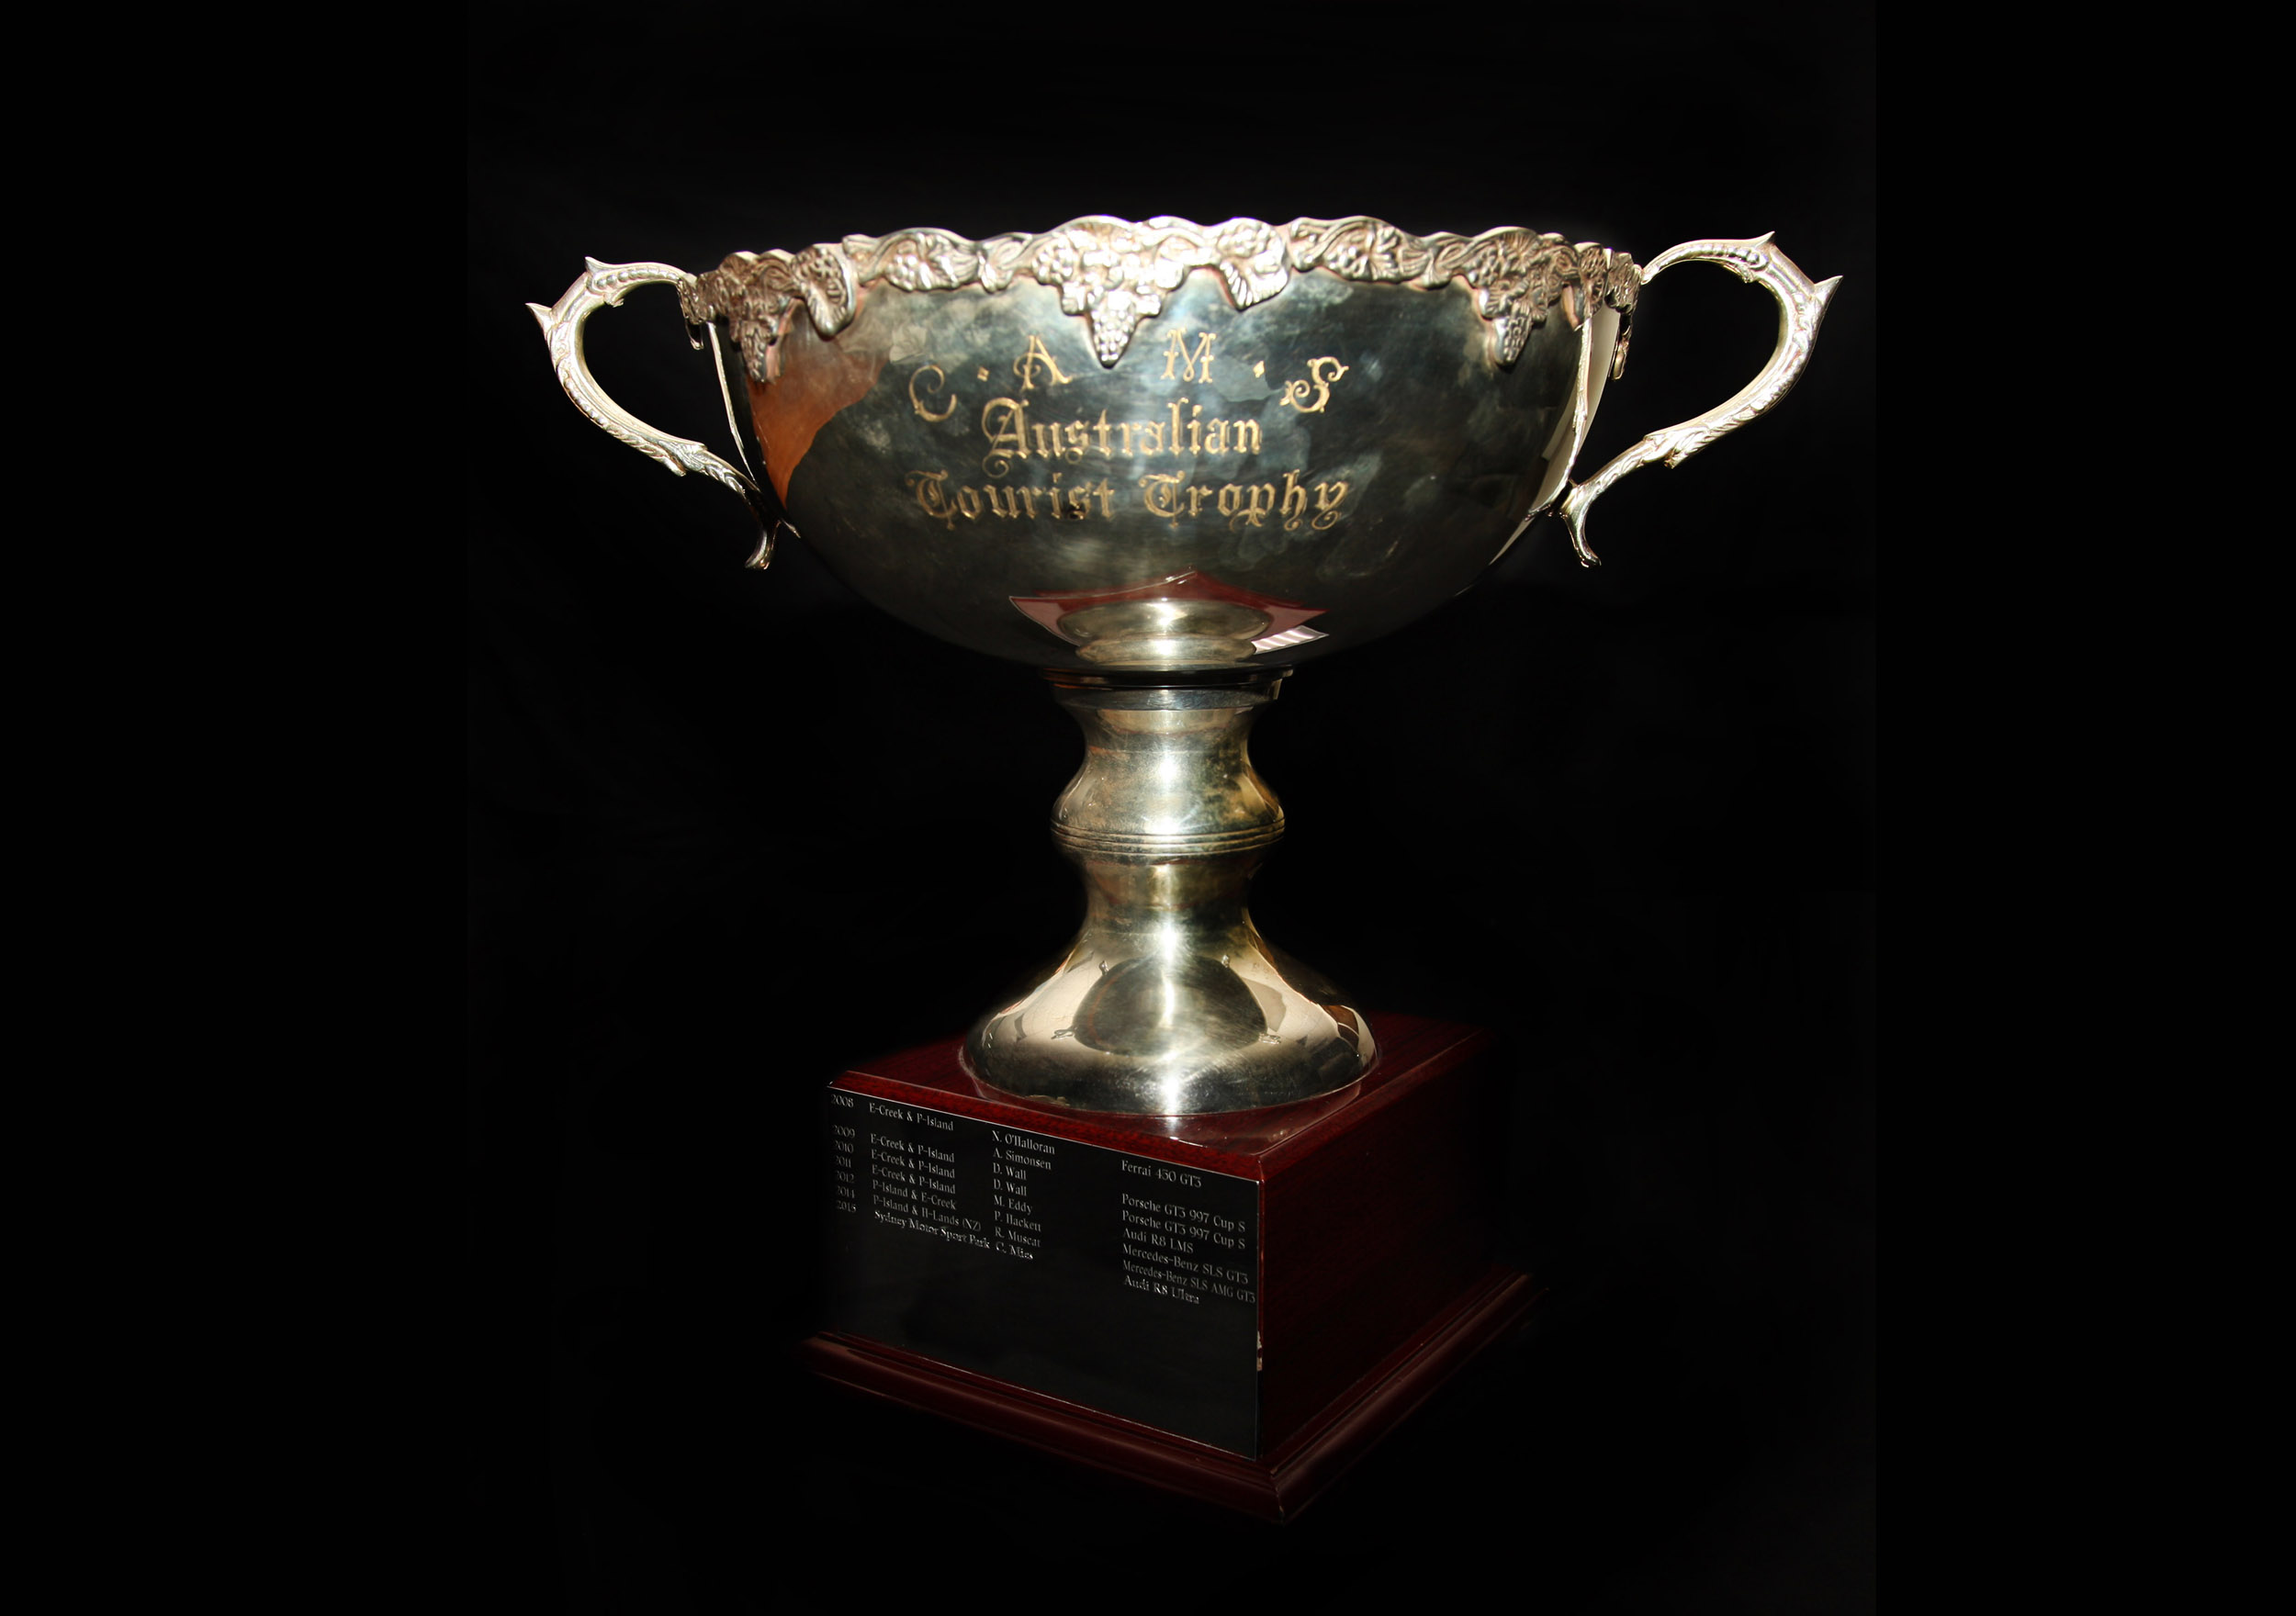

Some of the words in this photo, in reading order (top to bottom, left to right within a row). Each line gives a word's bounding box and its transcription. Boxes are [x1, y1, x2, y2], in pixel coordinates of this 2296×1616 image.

[908, 365, 957, 422] C
[1013, 334, 1074, 391] A
[1161, 328, 1216, 384] M
[1279, 356, 1349, 413] S
[982, 397, 1262, 477] Australian
[906, 469, 1115, 530] Tourist
[1139, 469, 1348, 532] Trophy
[830, 1094, 854, 1108] 2008
[832, 1124, 856, 1139] 2009
[869, 1103, 904, 1121] E-Creek
[906, 1111, 913, 1122] &
[917, 1113, 954, 1131] P-Island
[833, 1139, 854, 1154] 2010
[871, 1134, 905, 1151] E-Creek
[907, 1142, 914, 1153] &
[918, 1145, 955, 1163] P-Island
[992, 1130, 1002, 1143] N.
[1005, 1133, 1055, 1155] O'Halloran
[871, 1150, 905, 1167] E-Creek
[908, 1158, 915, 1169] &
[918, 1161, 955, 1179] P-Island
[993, 1148, 1003, 1160] A.
[1005, 1150, 1052, 1171] Simonsen
[993, 1162, 1003, 1174] D.
[1006, 1165, 1027, 1181] Wall
[1121, 1160, 1152, 1177] Ferrai
[1180, 1173, 1202, 1188] GT3
[872, 1164, 906, 1183] E-Creek
[909, 1173, 916, 1184] &
[919, 1176, 955, 1194] P-Island
[994, 1178, 1003, 1191] D.
[1006, 1181, 1027, 1196] Wall
[872, 1180, 908, 1198] P-Island
[911, 1188, 917, 1200] &
[921, 1192, 957, 1210] E-Creek
[994, 1195, 1005, 1207] M.
[1008, 1198, 1032, 1216] Eddy
[873, 1195, 909, 1213] P-Island
[912, 1204, 918, 1216] &
[921, 1208, 960, 1227] H-Lands
[995, 1210, 1003, 1223] P.
[1006, 1213, 1041, 1232] Hackett
[1121, 1194, 1161, 1213] Porsche
[1165, 1204, 1186, 1218] GT3
[1189, 1209, 1210, 1224] 997
[1213, 1216, 1234, 1232] Cup
[1238, 1221, 1245, 1232] S
[874, 1210, 908, 1229] Sydney
[909, 1218, 939, 1236] Motor
[969, 1234, 990, 1249] Park
[995, 1227, 1005, 1239] R.
[1008, 1230, 1041, 1248] Muscat
[1122, 1210, 1161, 1229] Porsche
[1165, 1221, 1186, 1236] GT3
[1189, 1227, 1210, 1240] 997
[1213, 1233, 1234, 1250] Cup
[1238, 1239, 1245, 1250] S
[1123, 1228, 1147, 1242] Audi
[1151, 1234, 1166, 1247] R8
[1170, 1238, 1194, 1254] LMS
[1122, 1243, 1199, 1273] Mercedes-Benz
[1202, 1263, 1223, 1278] SLS
[1226, 1270, 1248, 1285] GT3
[1122, 1260, 1187, 1285] Mercedes-Benz
[1190, 1277, 1208, 1290] SLS
[1210, 1283, 1233, 1298] AMG
[1237, 1290, 1256, 1304] GT3
[1124, 1274, 1149, 1291] Audi
[1154, 1282, 1168, 1296] R8
[1172, 1286, 1199, 1305] Ultra
